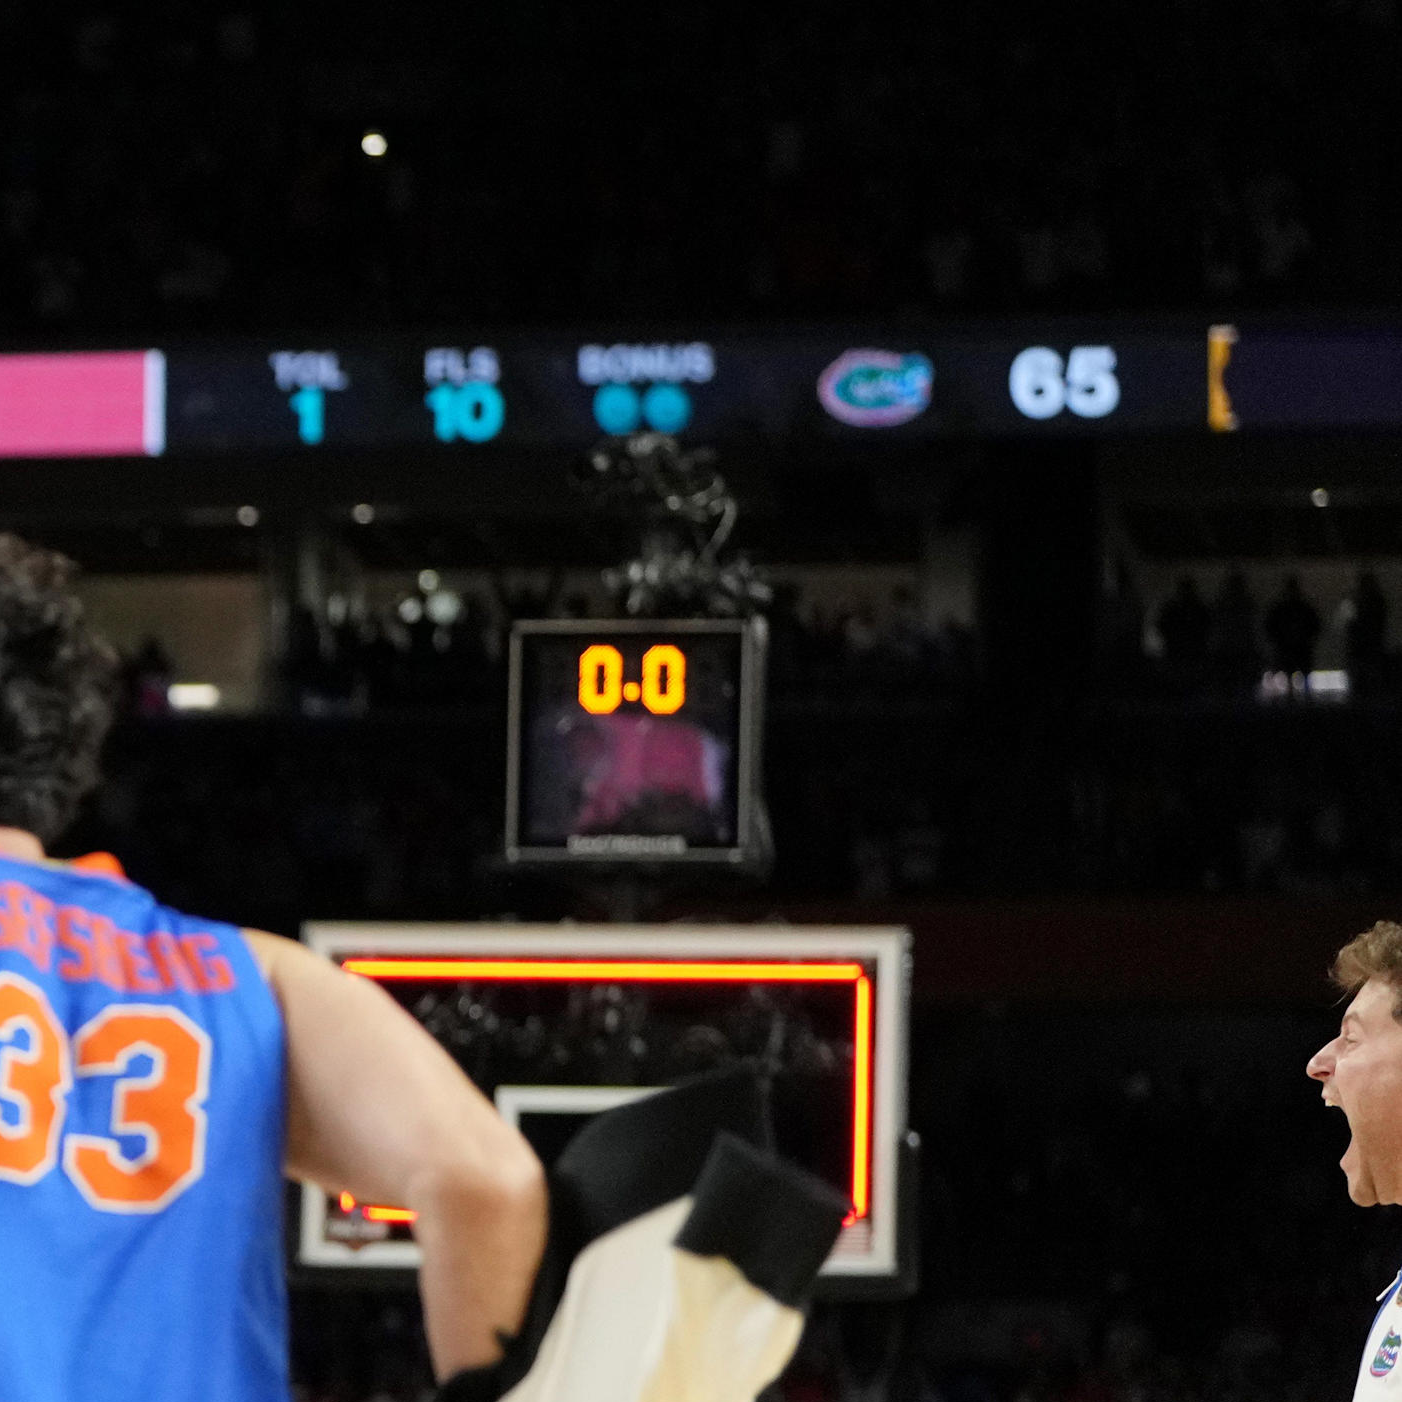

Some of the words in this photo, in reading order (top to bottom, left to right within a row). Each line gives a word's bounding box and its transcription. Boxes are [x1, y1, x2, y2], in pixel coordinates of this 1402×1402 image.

[291, 386, 325, 445] 1
[424, 381, 505, 442] 10
[1009, 345, 1120, 420] 65
[578, 644, 687, 715] 0.0
